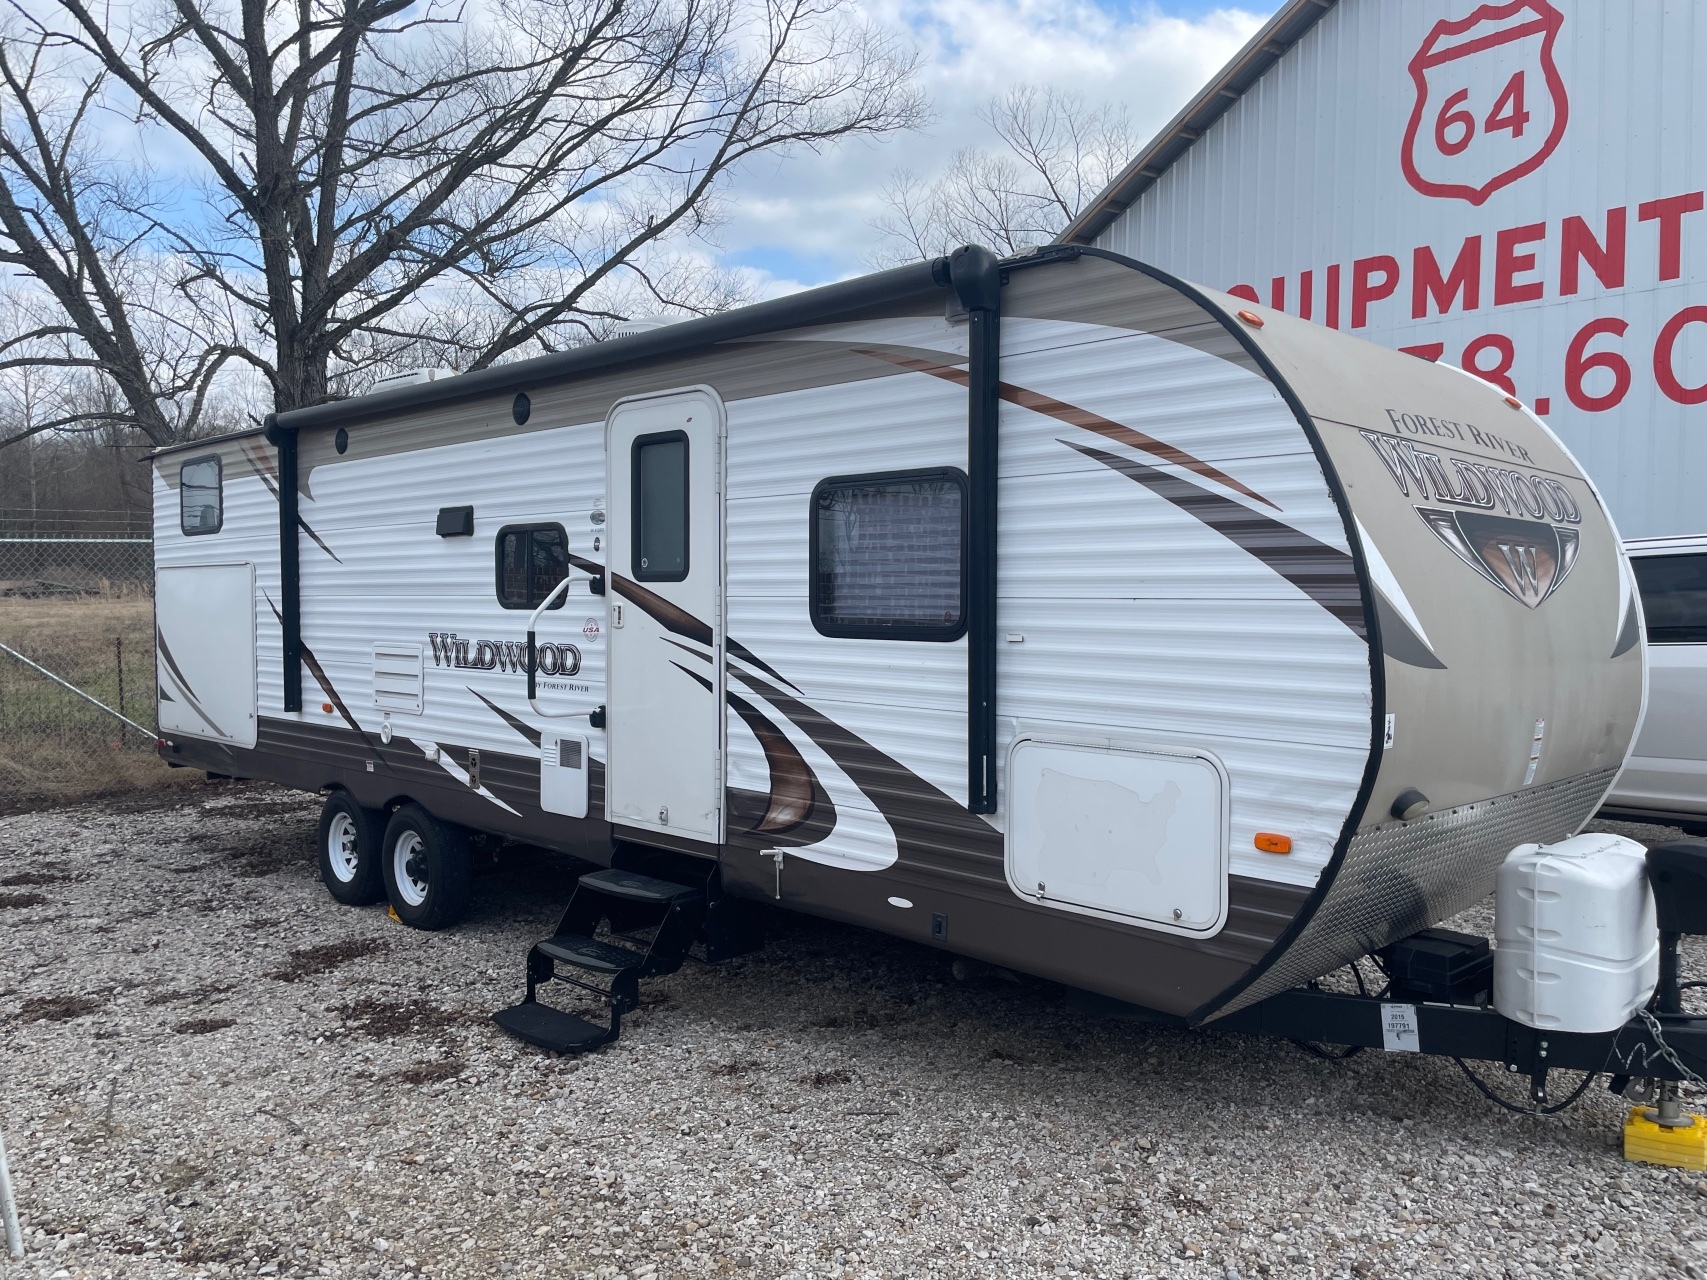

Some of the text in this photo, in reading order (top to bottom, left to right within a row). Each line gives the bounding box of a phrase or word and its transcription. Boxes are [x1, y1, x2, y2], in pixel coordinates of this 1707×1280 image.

[1435, 70, 1530, 156] 64
[1226, 191, 1704, 330] UIPMENT
[1385, 408, 1536, 465] FOREST RIVER
[1358, 429, 1582, 525] WILDWOOD
[1498, 544, 1538, 597] W
[428, 632, 582, 677] WILDWOOD
[543, 681, 567, 691] FOREST
[569, 683, 589, 693] RIVER
[1387, 1022, 1410, 1030] 197791
